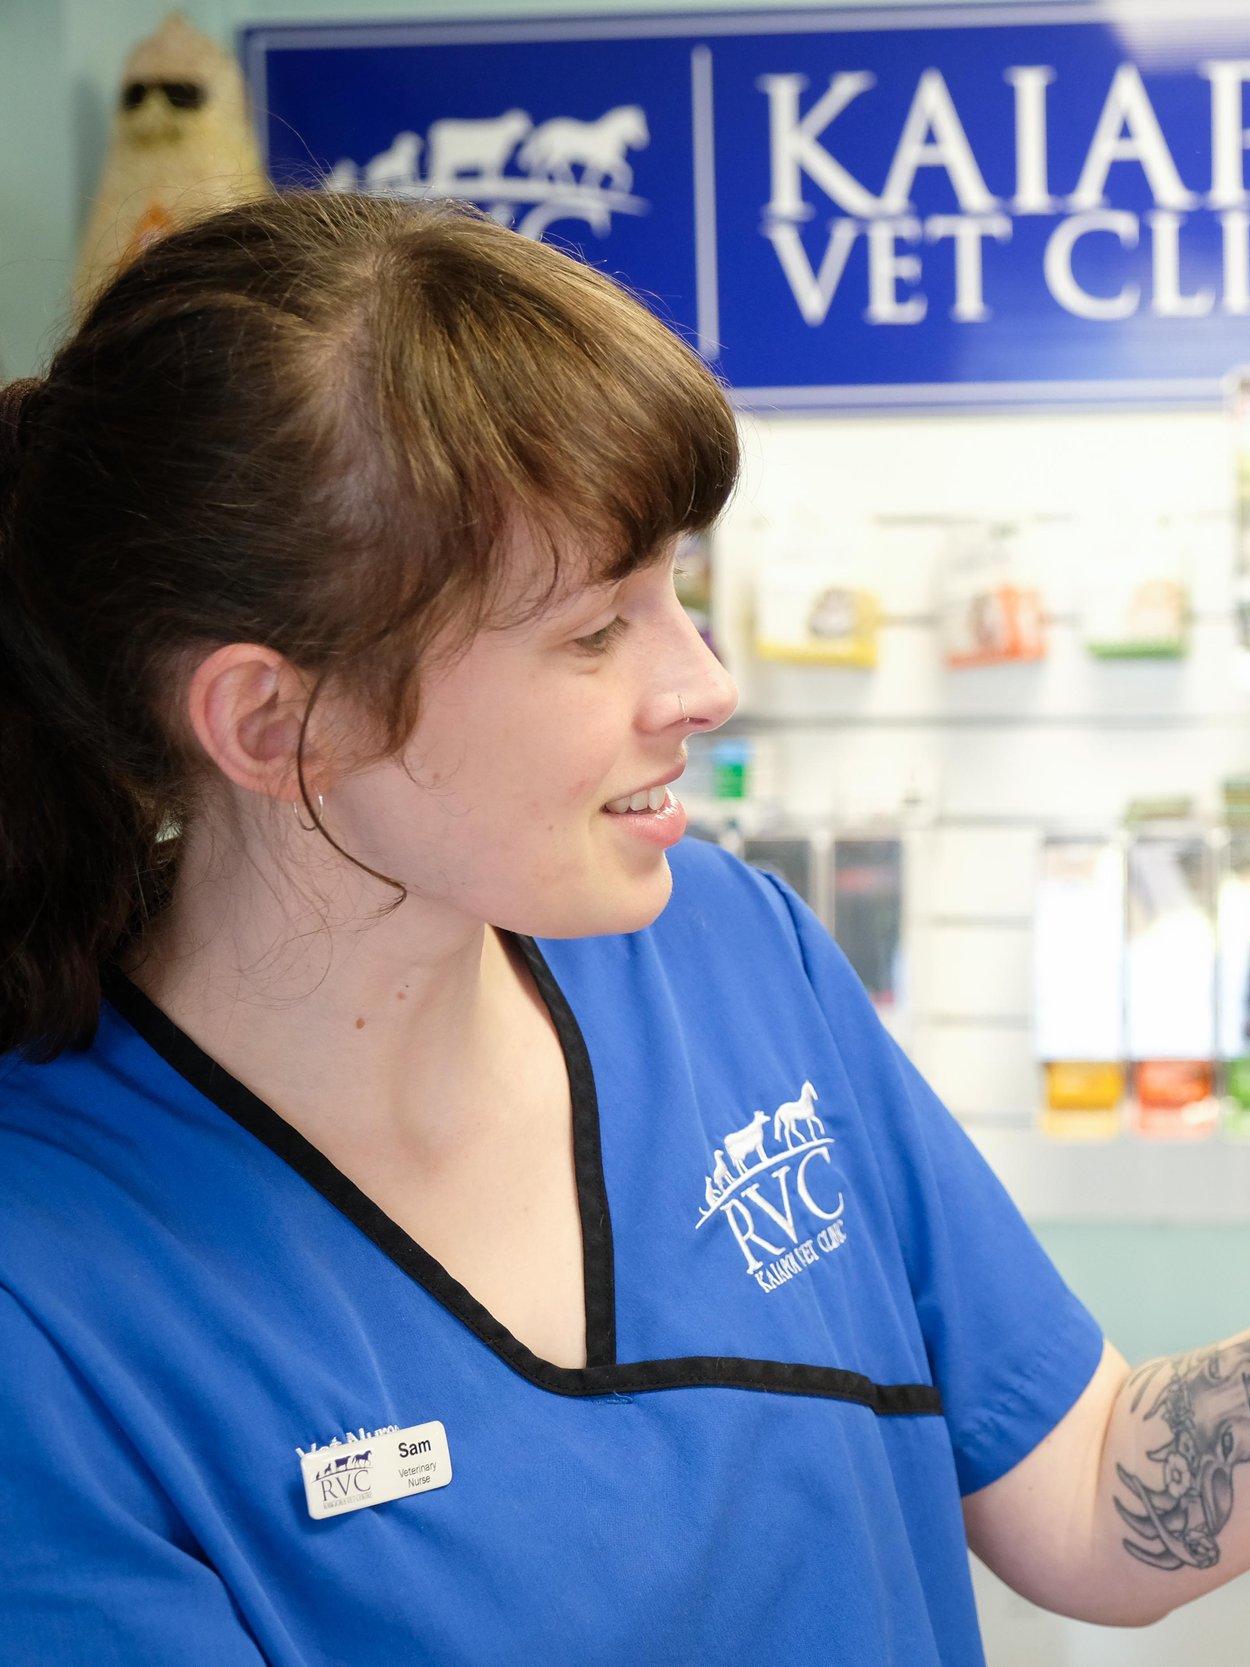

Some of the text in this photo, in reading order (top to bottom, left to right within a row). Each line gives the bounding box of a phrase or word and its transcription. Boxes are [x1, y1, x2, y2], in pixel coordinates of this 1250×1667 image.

[760, 213, 1010, 326] VET
[720, 1146, 844, 1275] RVC
[398, 1439, 432, 1458] Sam
[398, 1461, 437, 1478] Veterinary
[408, 1475, 431, 1488] Nurse
[321, 1469, 371, 1501] RVC
